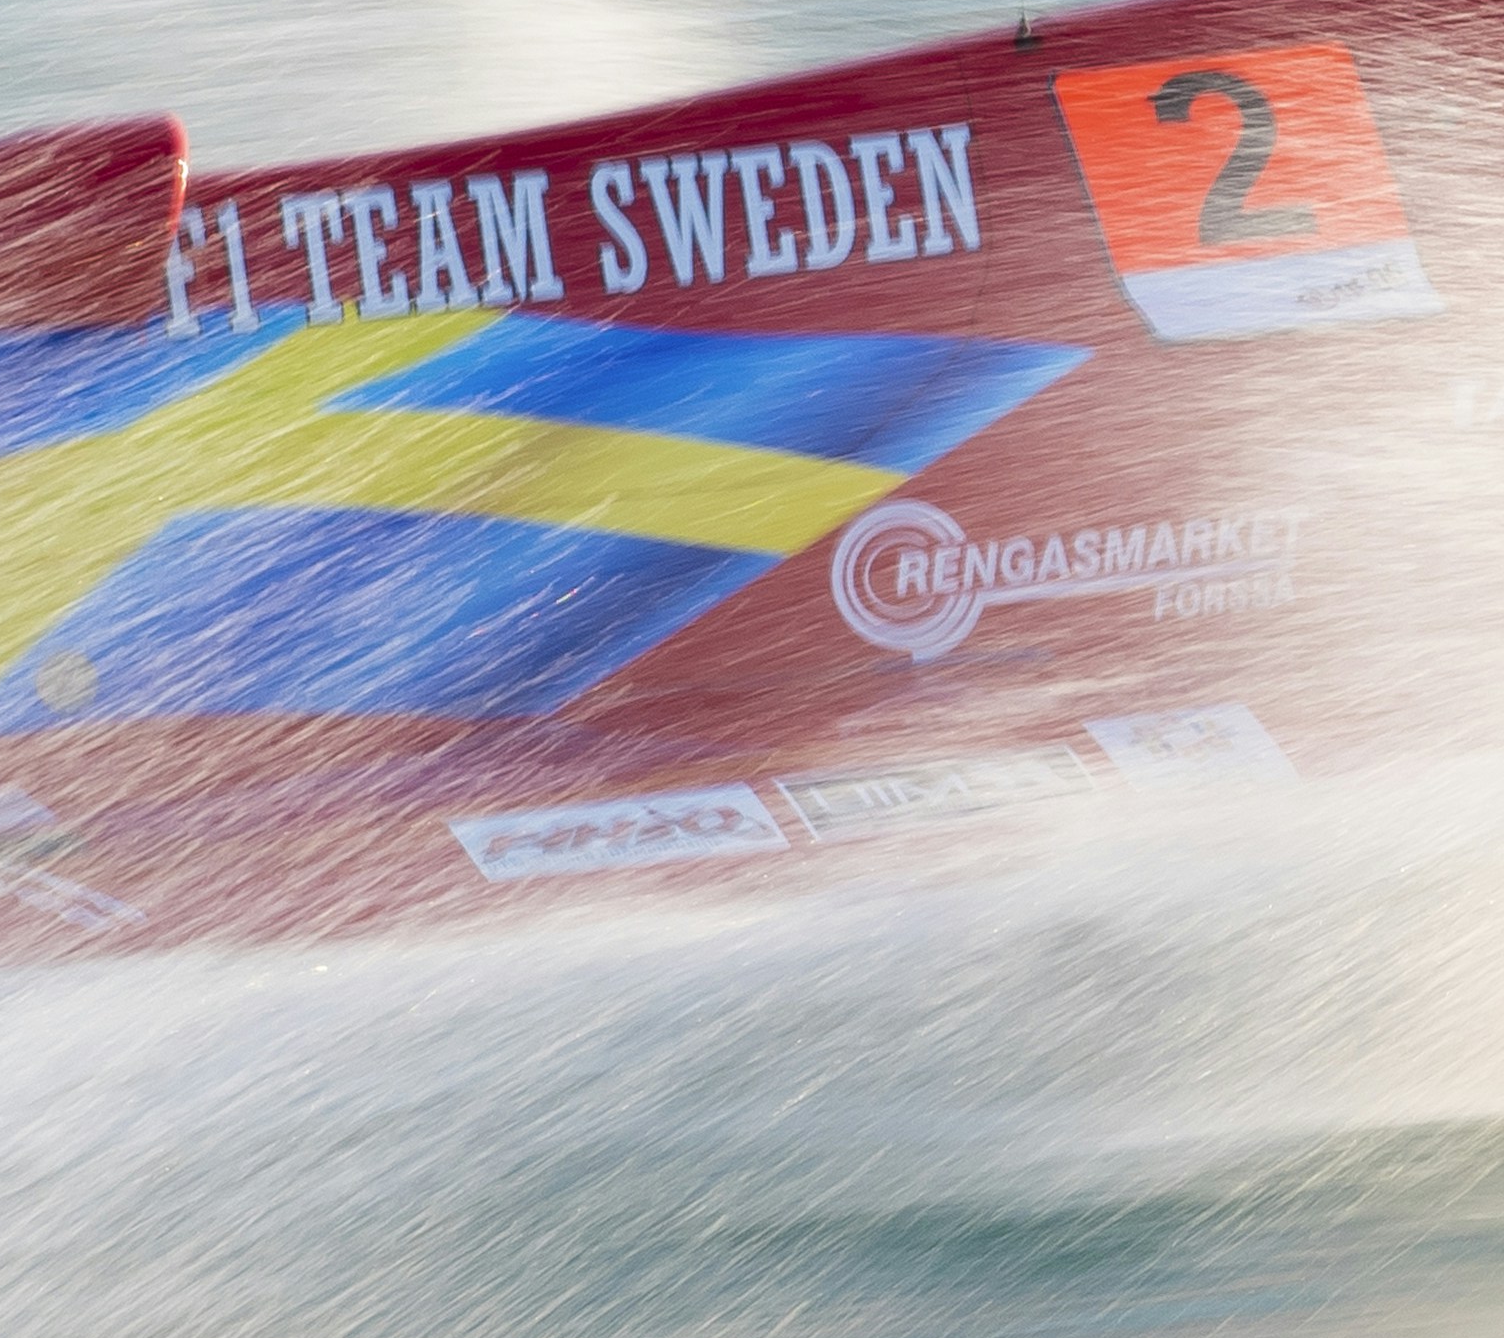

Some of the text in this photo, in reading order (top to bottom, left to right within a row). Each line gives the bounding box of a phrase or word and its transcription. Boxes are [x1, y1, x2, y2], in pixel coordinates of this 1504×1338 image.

[165, 122, 981, 340] F1 TEAM SWEDEN
[1148, 70, 1319, 246] 2
[897, 505, 1310, 599] RENGASMARKET
